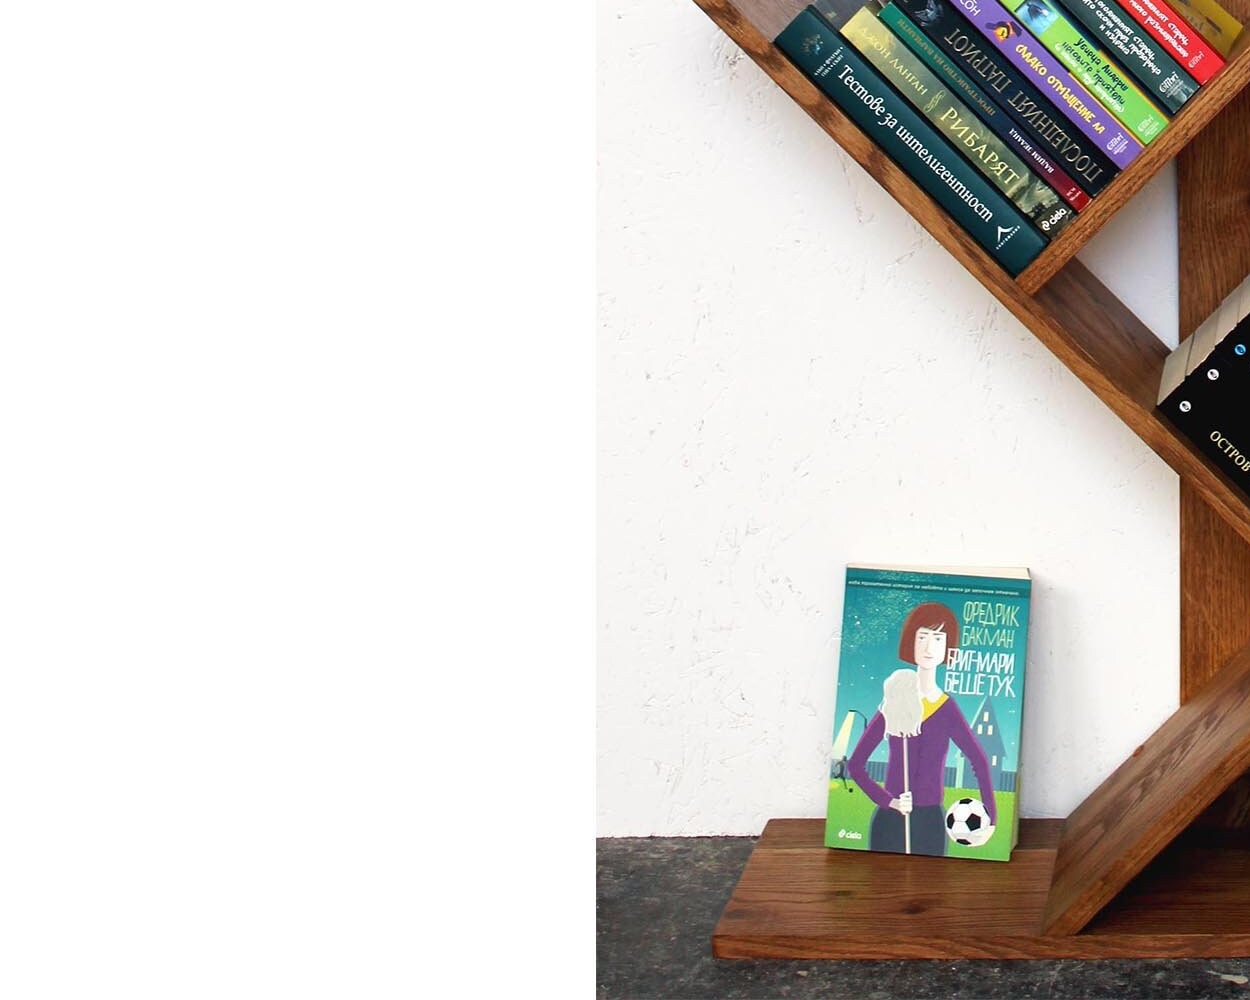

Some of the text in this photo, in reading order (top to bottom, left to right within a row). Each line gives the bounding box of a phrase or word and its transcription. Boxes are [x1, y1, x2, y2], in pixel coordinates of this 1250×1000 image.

[887, 55, 929, 97] ЛАНГАН
[942, 24, 1013, 95] ПАТРИОТ
[1043, 71, 1097, 125] ОТМЪЩЕНИЕ
[834, 62, 995, 225] Тестове за интелигентност
[938, 105, 1022, 189] РИБАРЯТ
[1005, 86, 1104, 185] ПОСЛЕДНИЯТ
[1045, 204, 1068, 227] ciela
[960, 625, 1016, 650] БАКМАН
[962, 600, 1021, 628] ФРЕДРИК
[943, 670, 1017, 699] БЕШЕ ТУК
